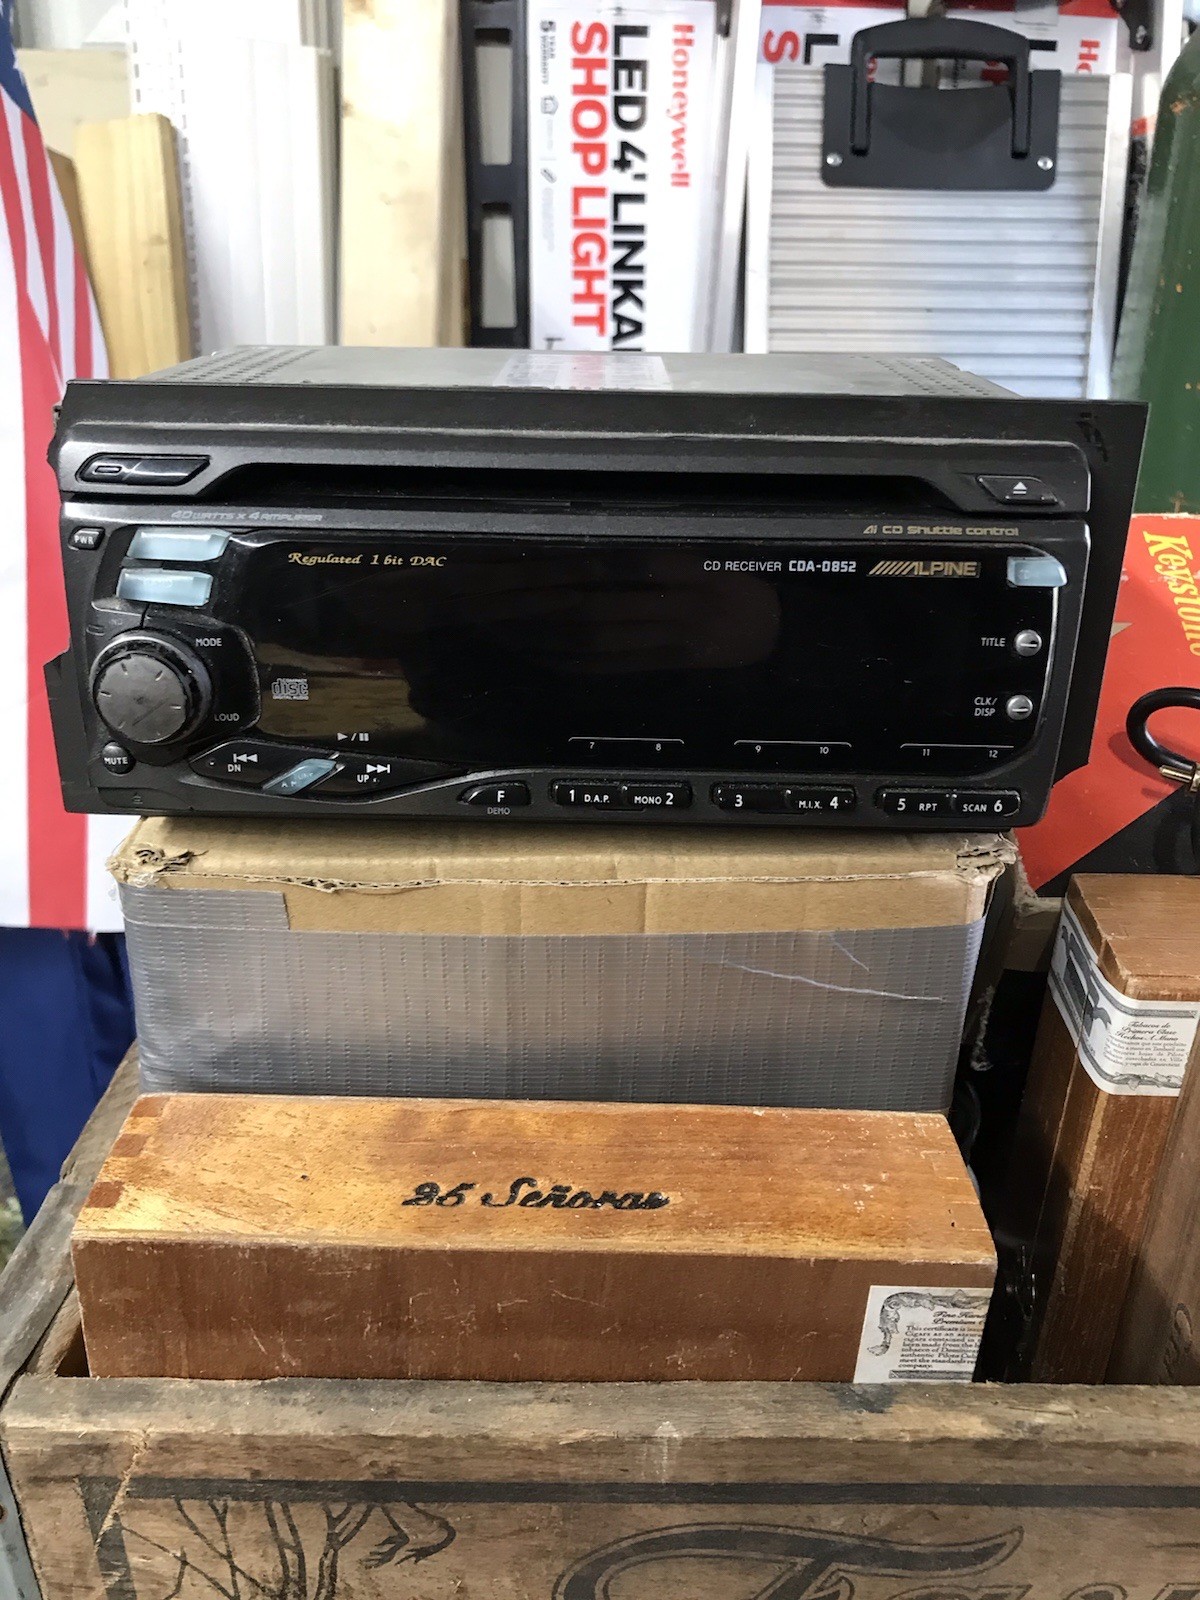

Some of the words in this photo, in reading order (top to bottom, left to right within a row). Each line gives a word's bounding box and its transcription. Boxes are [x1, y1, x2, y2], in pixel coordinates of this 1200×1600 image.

[612, 25, 649, 132] LED
[570, 21, 609, 177] SHOP
[666, 24, 694, 188] Honeywell
[611, 141, 647, 182] 4'
[570, 186, 608, 338] LIGHT
[611, 193, 646, 352] LINKA
[882, 525, 903, 535] CD
[965, 527, 1019, 536] control
[74, 534, 94, 545] PWR
[288, 552, 363, 566] Regulated
[370, 554, 380, 565] 1
[383, 554, 404, 566] bit
[409, 556, 448, 567] DAC
[703, 560, 721, 571] CD
[724, 560, 782, 572] RECEIVER
[899, 560, 977, 576] ALPINE
[195, 638, 222, 647] MODE
[981, 637, 1006, 647] TITLE
[974, 696, 998, 706] CLK/
[214, 713, 240, 722] LOUD
[974, 707, 996, 717] DISP
[589, 742, 596, 750] 7
[655, 743, 662, 751] 8
[755, 745, 762, 753] 9
[819, 746, 830, 754] 10
[922, 748, 930, 756] 11
[988, 750, 999, 758] 12
[104, 756, 129, 766] MUTE
[227, 764, 241, 773] DN
[357, 774, 370, 783] UP
[497, 790, 505, 803] F
[569, 790, 576, 802] 1
[634, 796, 662, 805] MONO
[665, 793, 674, 805] 2
[734, 794, 743, 808] 3
[829, 796, 839, 809] 4
[897, 798, 906, 811] 5
[918, 803, 938, 812] RPT
[962, 804, 988, 813] SCAN
[993, 799, 1003, 813] 6
[487, 807, 511, 815] DEMO
